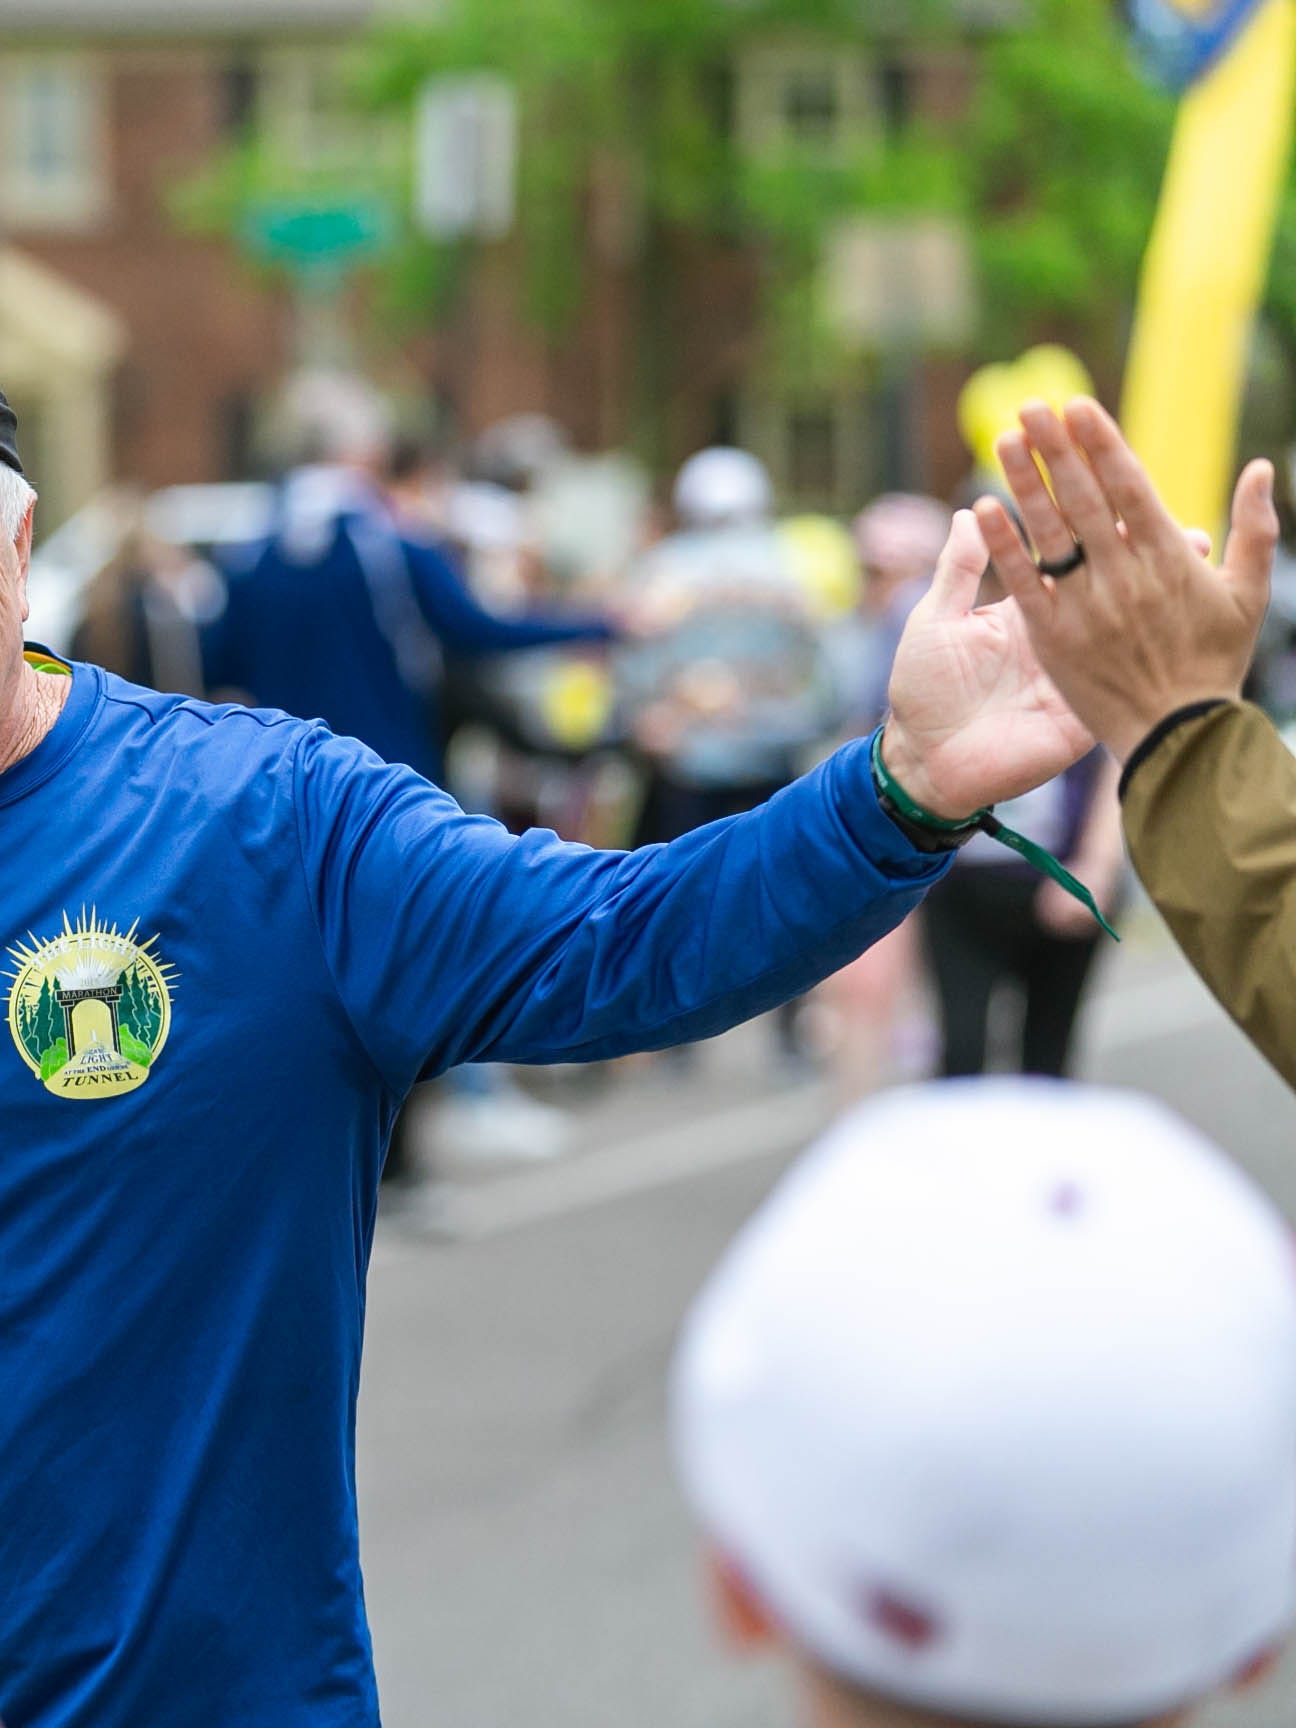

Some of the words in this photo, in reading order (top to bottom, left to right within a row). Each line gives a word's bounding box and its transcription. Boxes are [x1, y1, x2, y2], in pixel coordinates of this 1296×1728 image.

[31, 938, 72, 968] THE
[77, 934, 139, 961] LIGHT
[62, 986, 117, 1000] MARATHON
[80, 1053, 113, 1065] LIGHT
[87, 1065, 106, 1074] END
[62, 1071, 139, 1088] TUNNEL
